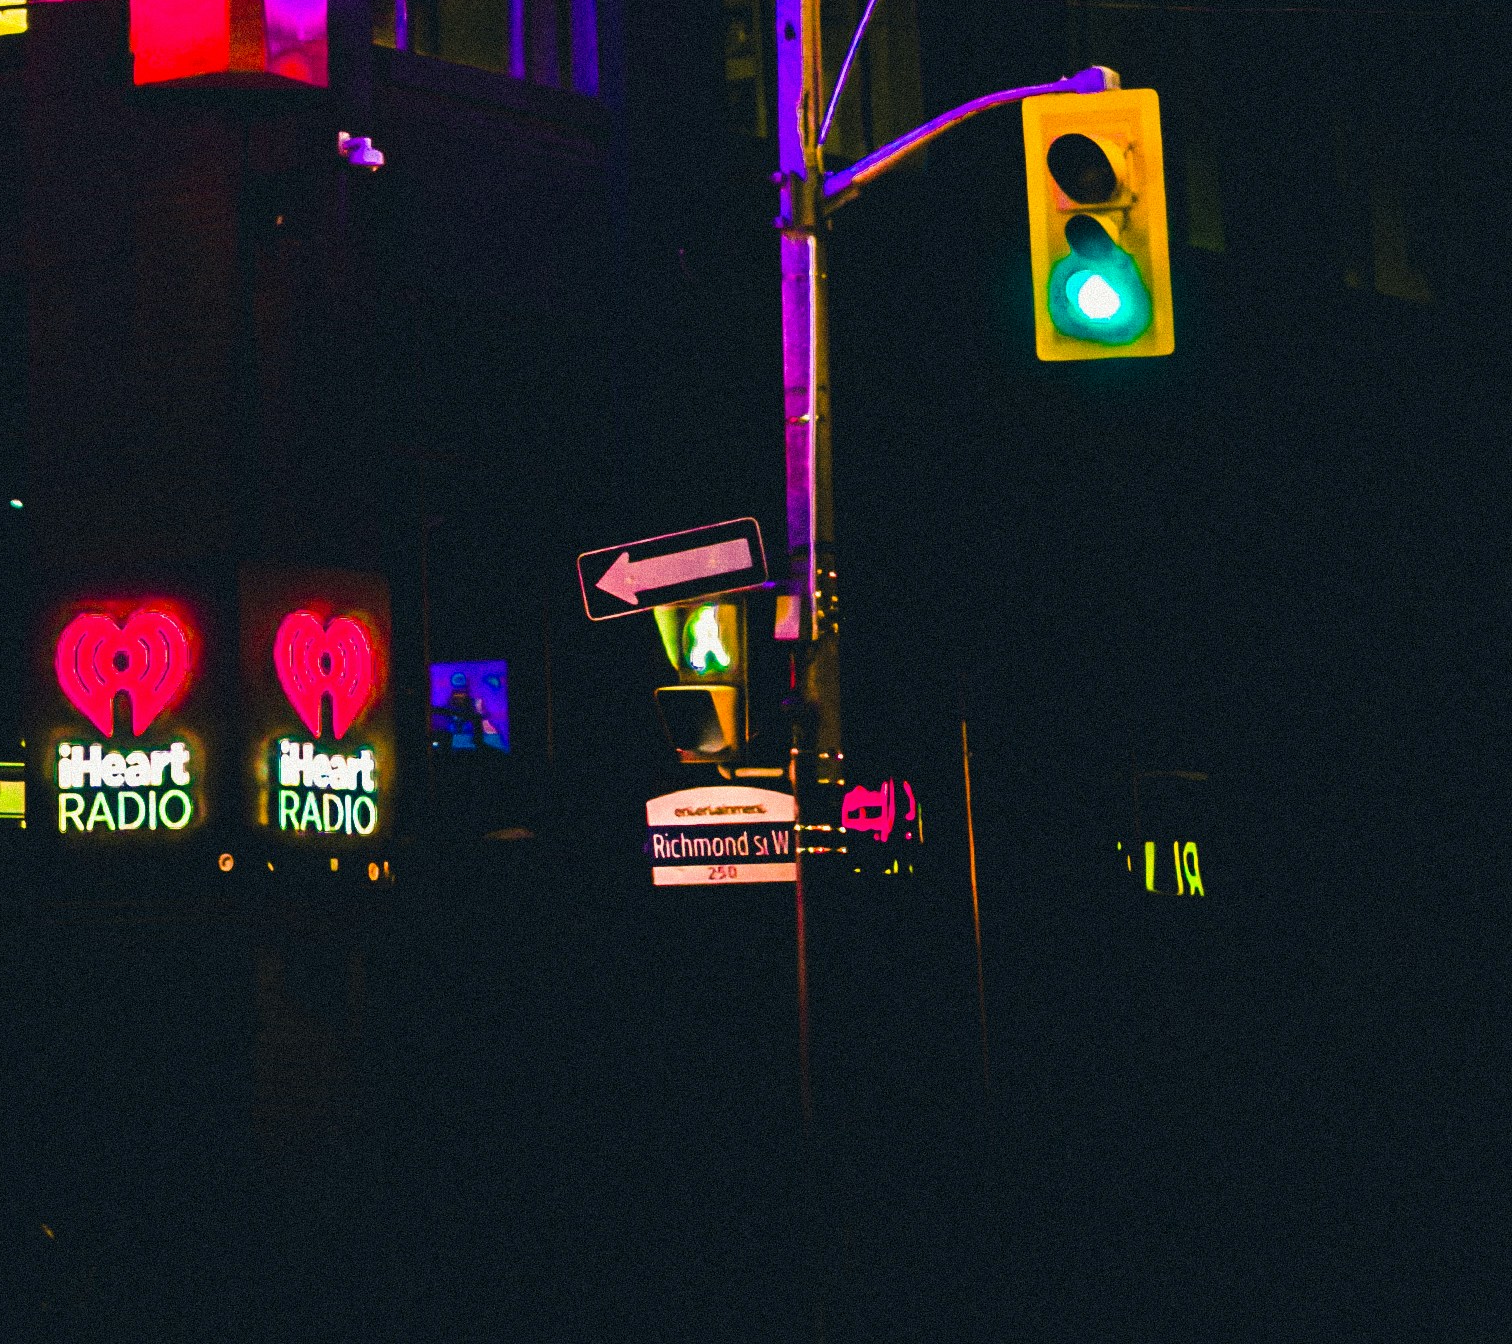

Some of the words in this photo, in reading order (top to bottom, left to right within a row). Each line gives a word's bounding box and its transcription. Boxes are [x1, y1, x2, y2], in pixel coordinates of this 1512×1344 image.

[58, 742, 190, 789] iHeart
[278, 738, 375, 792] iHeart
[58, 790, 192, 834] RADIO
[278, 789, 377, 835] RADIO
[652, 830, 750, 859] Richmond
[753, 835, 770, 856] St
[771, 829, 789, 855] W
[707, 866, 738, 881] 250
